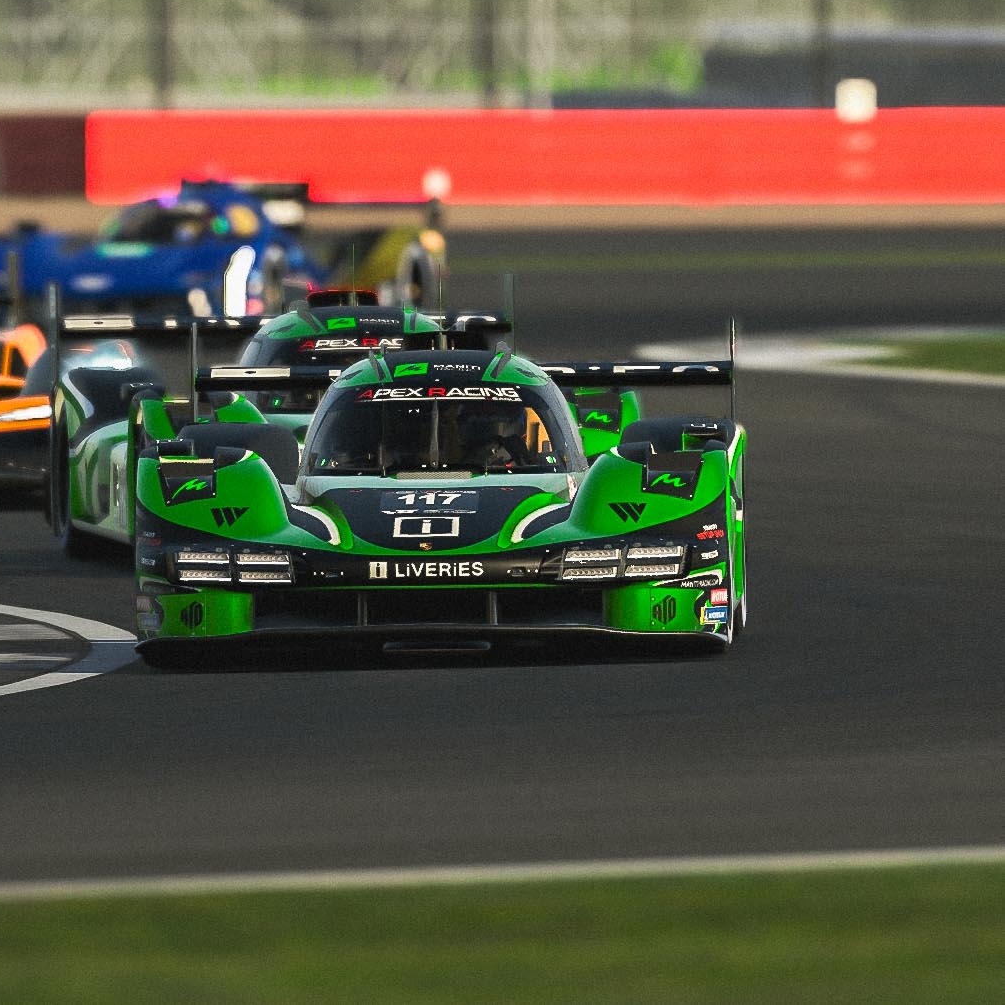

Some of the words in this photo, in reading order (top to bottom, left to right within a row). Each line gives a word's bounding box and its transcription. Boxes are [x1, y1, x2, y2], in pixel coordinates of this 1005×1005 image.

[298, 339, 358, 351] APEX
[362, 338, 403, 348] RAC
[357, 387, 423, 400] APEX
[428, 387, 520, 398] RACING
[398, 493, 462, 505] 117
